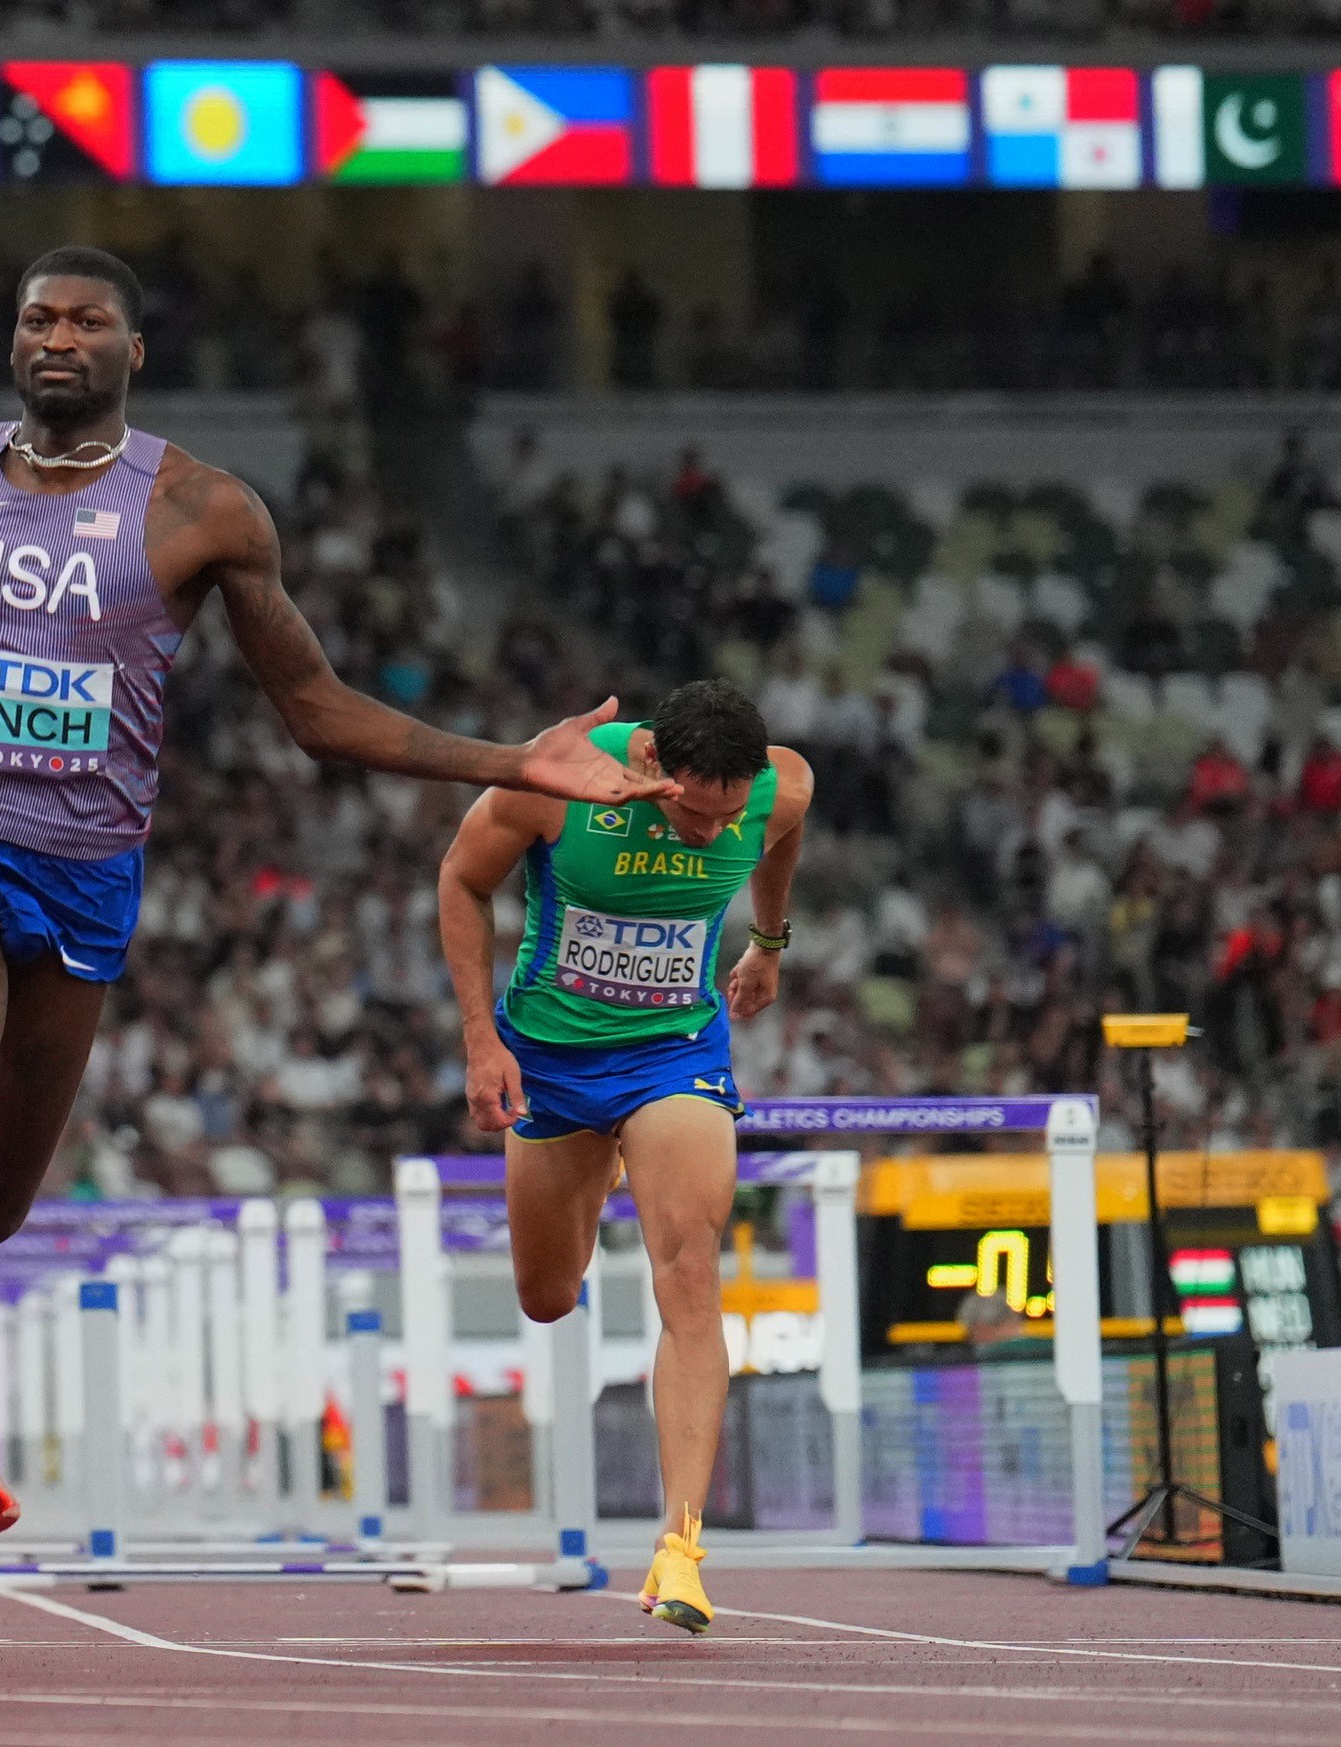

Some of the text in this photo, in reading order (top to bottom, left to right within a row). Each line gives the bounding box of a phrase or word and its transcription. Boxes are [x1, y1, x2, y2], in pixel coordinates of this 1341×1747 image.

[614, 851, 709, 879] BRASIL
[605, 919, 700, 949] TDK
[565, 940, 696, 984] RODRIGUES
[832, 1106, 1005, 1129] CHAMPIONSHIPS
